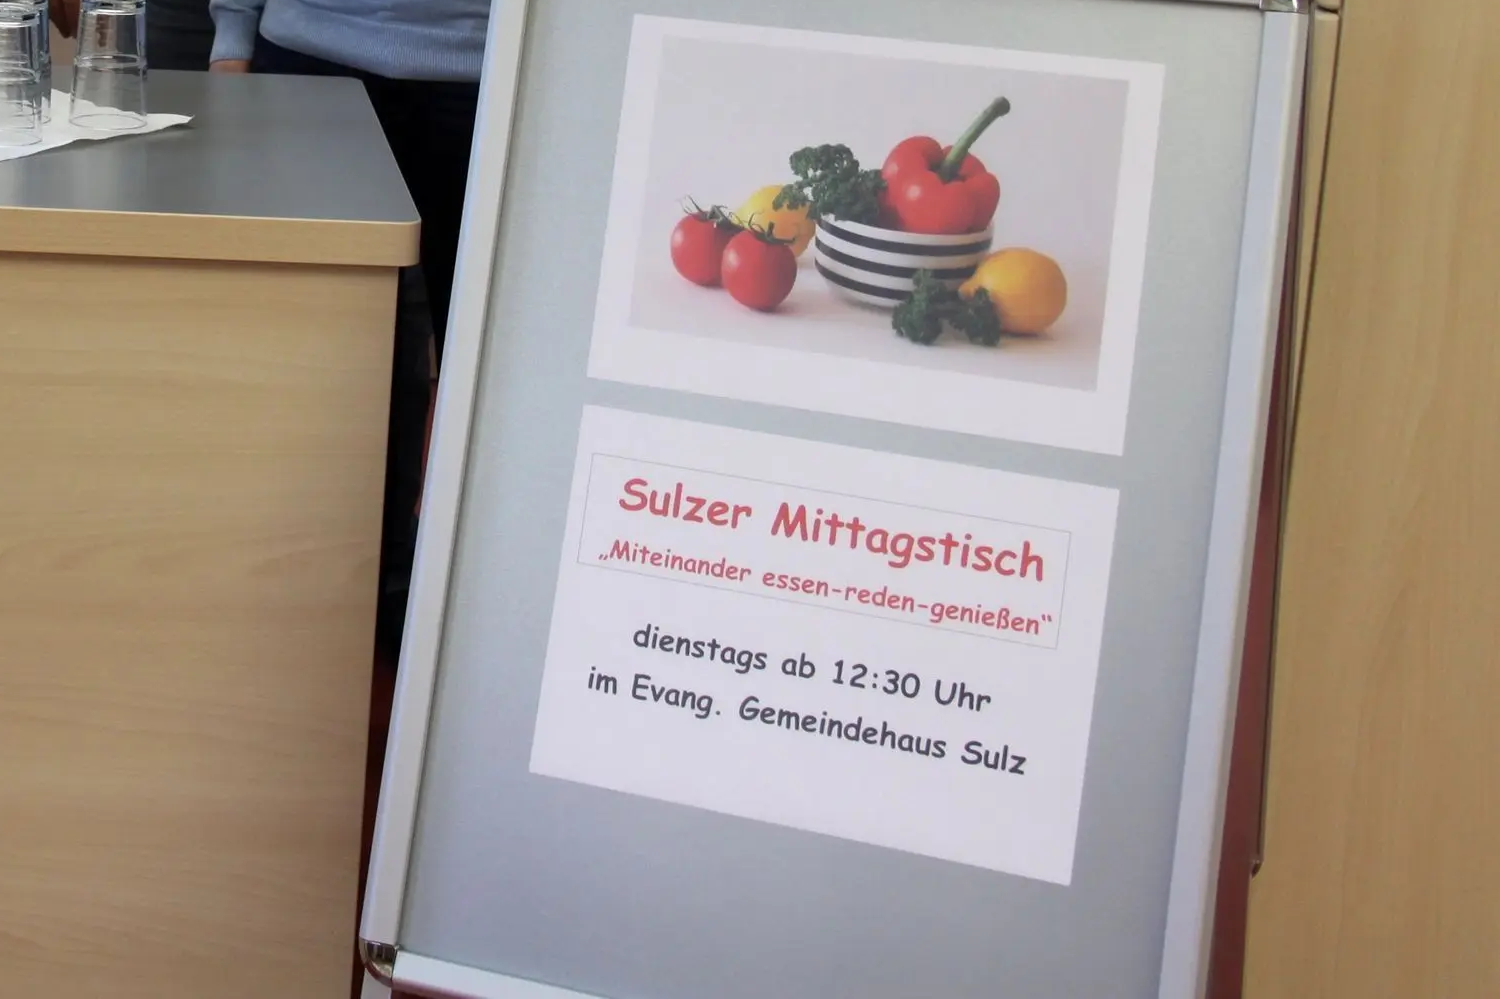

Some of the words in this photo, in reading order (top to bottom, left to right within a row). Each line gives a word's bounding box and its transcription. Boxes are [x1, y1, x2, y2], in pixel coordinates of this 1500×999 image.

[618, 478, 753, 529] Sulzer
[770, 501, 1044, 583] Mittagstisch
[587, 665, 618, 696] im
[631, 673, 721, 720] Evang.
[738, 695, 947, 759] Gemeindehaus
[960, 740, 1027, 776] Sulz
[632, 623, 768, 675] dienstags
[780, 651, 816, 680] ab
[832, 659, 921, 699] 12:30
[934, 678, 992, 713] Uhr
